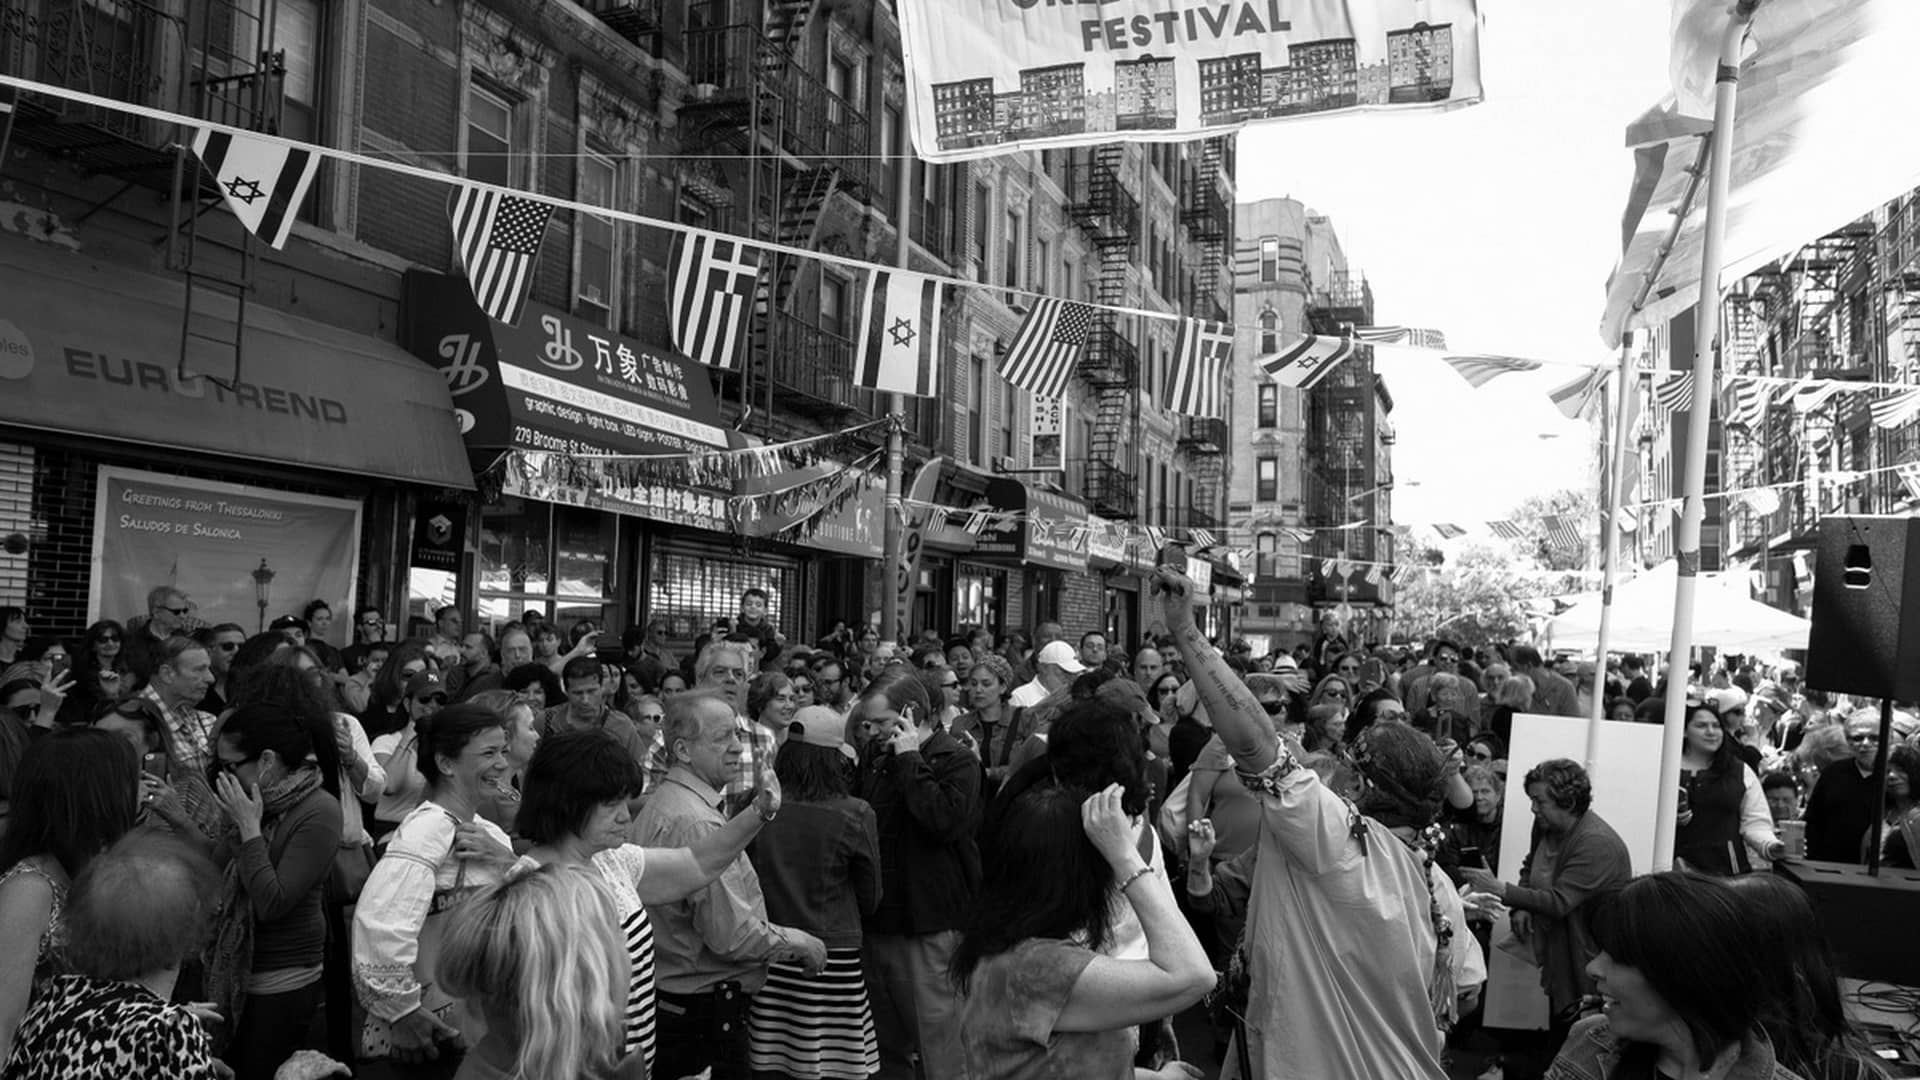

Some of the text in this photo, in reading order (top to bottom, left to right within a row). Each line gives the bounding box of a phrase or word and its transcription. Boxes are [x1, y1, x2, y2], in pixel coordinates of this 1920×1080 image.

[1081, 0, 1291, 52] FESTIVAL
[587, 334, 642, 384] 万象
[63, 347, 347, 424] EUROTREND
[514, 425, 532, 445] 279
[533, 430, 567, 452] Broome
[1035, 396, 1045, 432] USHI
